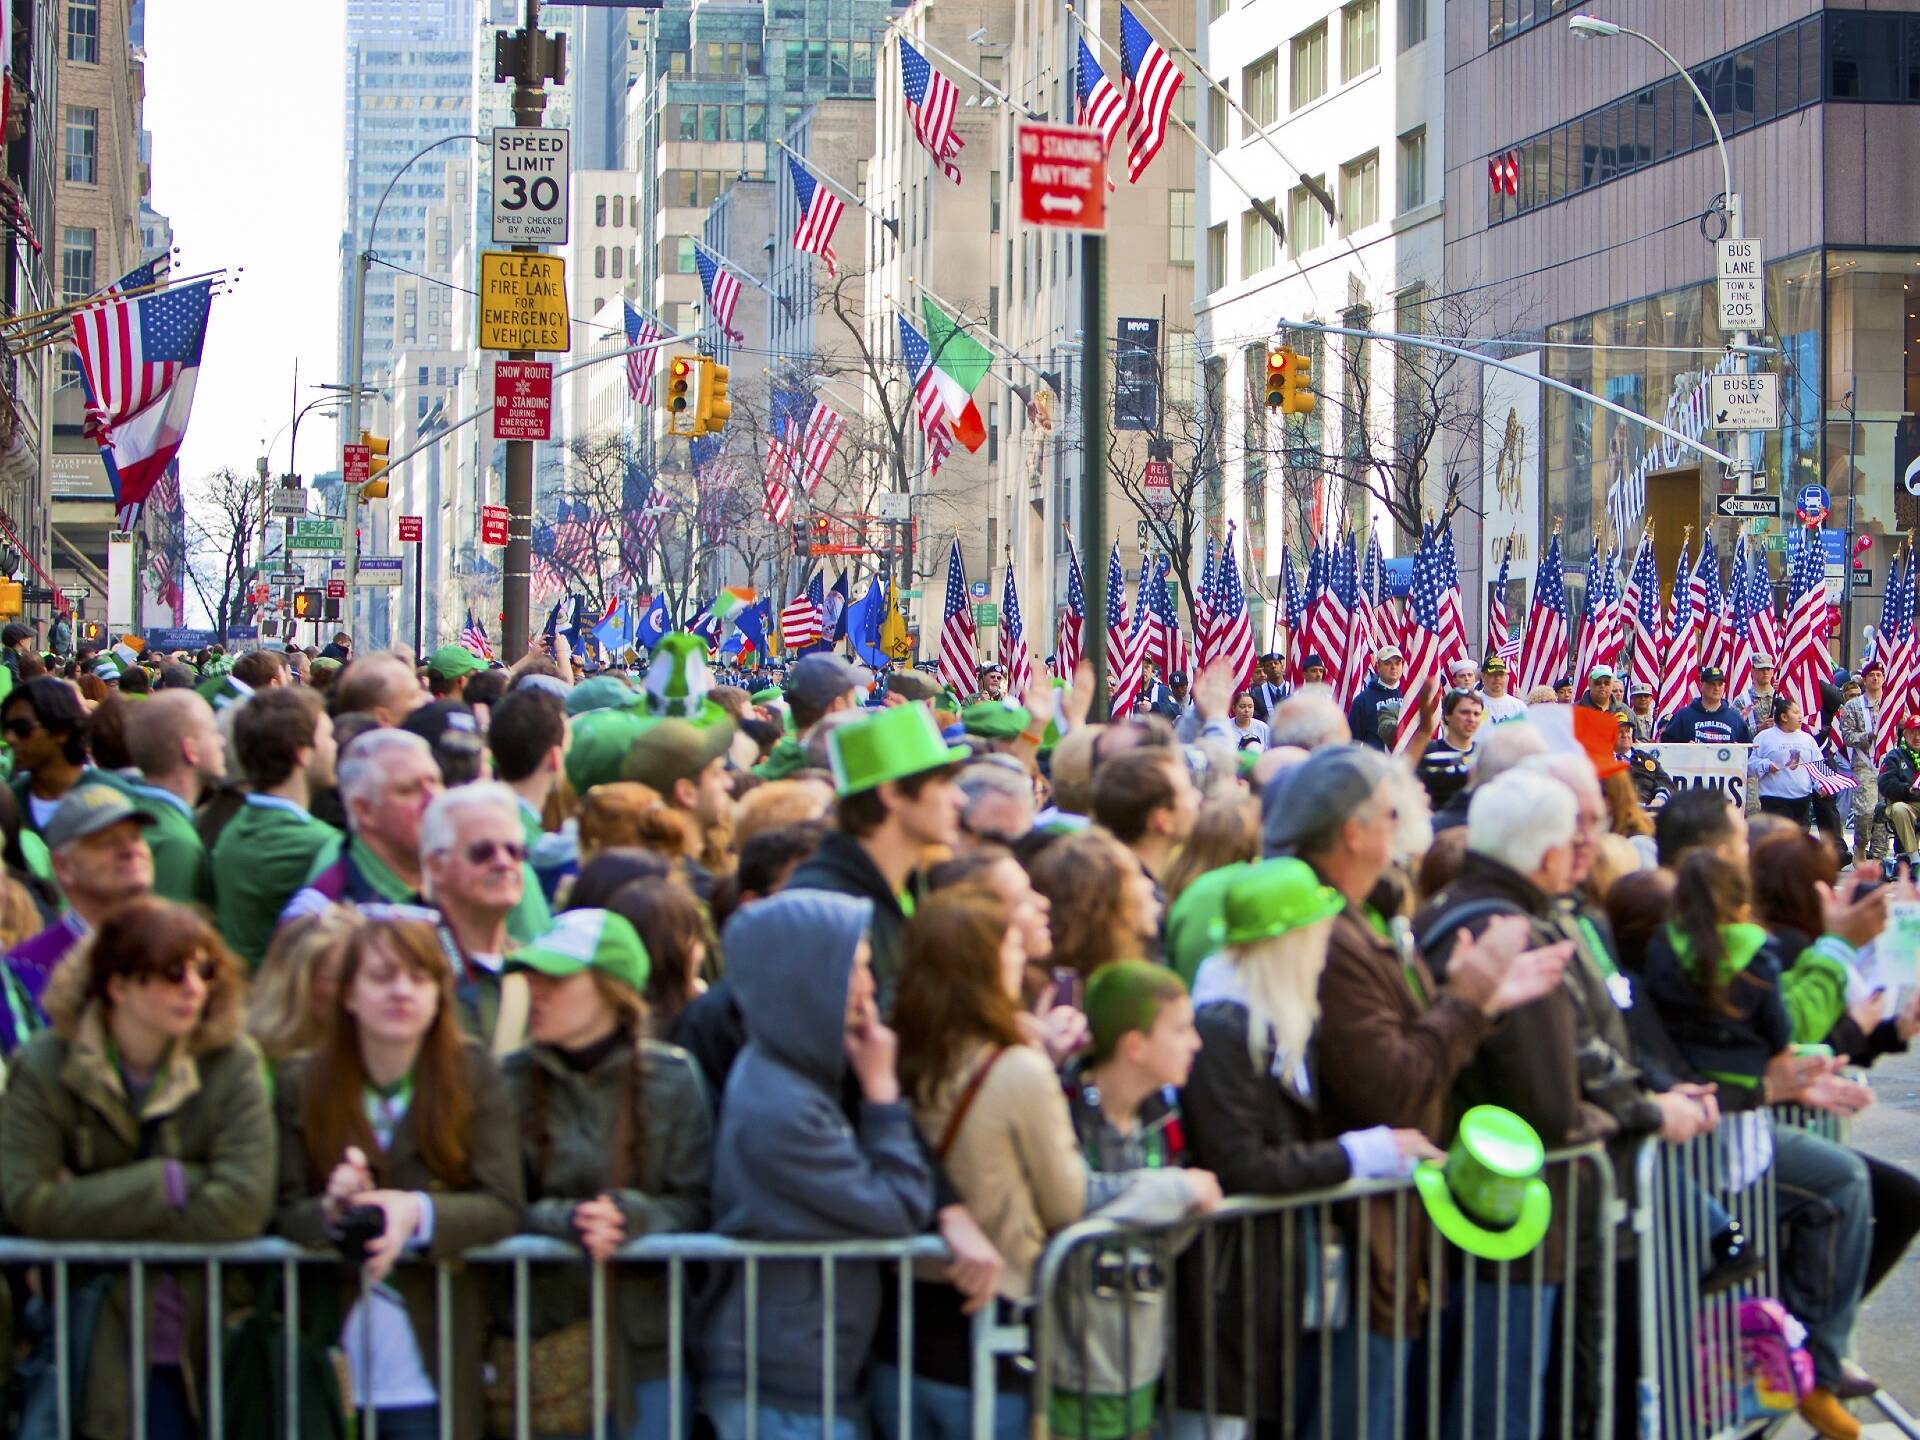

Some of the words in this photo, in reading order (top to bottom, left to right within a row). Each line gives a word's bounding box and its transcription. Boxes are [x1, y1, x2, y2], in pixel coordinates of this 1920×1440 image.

[499, 137, 564, 152] SPEED
[1022, 133, 1039, 156] NO
[1042, 134, 1101, 162] STANDING
[506, 156, 555, 172] LIMIT
[1031, 163, 1092, 190] ANYTIME
[500, 174, 560, 212] 30
[497, 216, 523, 224] SPEED
[527, 217, 564, 225] CHECKED
[508, 226, 519, 234] BY
[524, 226, 552, 234] RADAR
[1728, 244, 1752, 258] BUS
[500, 262, 551, 279] CLEAR
[1725, 261, 1756, 275] LANE
[491, 279, 519, 296] FIRE
[526, 281, 559, 297] LANE
[1726, 281, 1745, 290] TOW
[1748, 281, 1755, 290] &
[1731, 292, 1751, 301] FINE
[515, 297, 535, 309] FOR
[485, 309, 564, 327] EMERGENCY
[1127, 321, 1150, 332] NYC
[492, 328, 558, 344] VEHICLES
[497, 366, 520, 378] SNOW
[524, 367, 550, 379] ROUTE
[1723, 379, 1764, 390] BUSES
[496, 396, 508, 408] NO
[512, 396, 549, 409] STANDING
[1728, 393, 1760, 404] ONLY
[509, 409, 536, 418] DURING
[500, 418, 544, 428] EMERGENCY
[499, 427, 525, 436] VEHICLES
[1147, 475, 1170, 485] ZONE
[1726, 501, 1745, 510] ONE
[1752, 502, 1772, 511] WAY
[299, 522, 306, 534] E
[289, 538, 306, 547] PLACE
[316, 538, 340, 547] CARTIER
[1768, 536, 1777, 549] W
[1695, 721, 1732, 734] FAIRLEIGH
